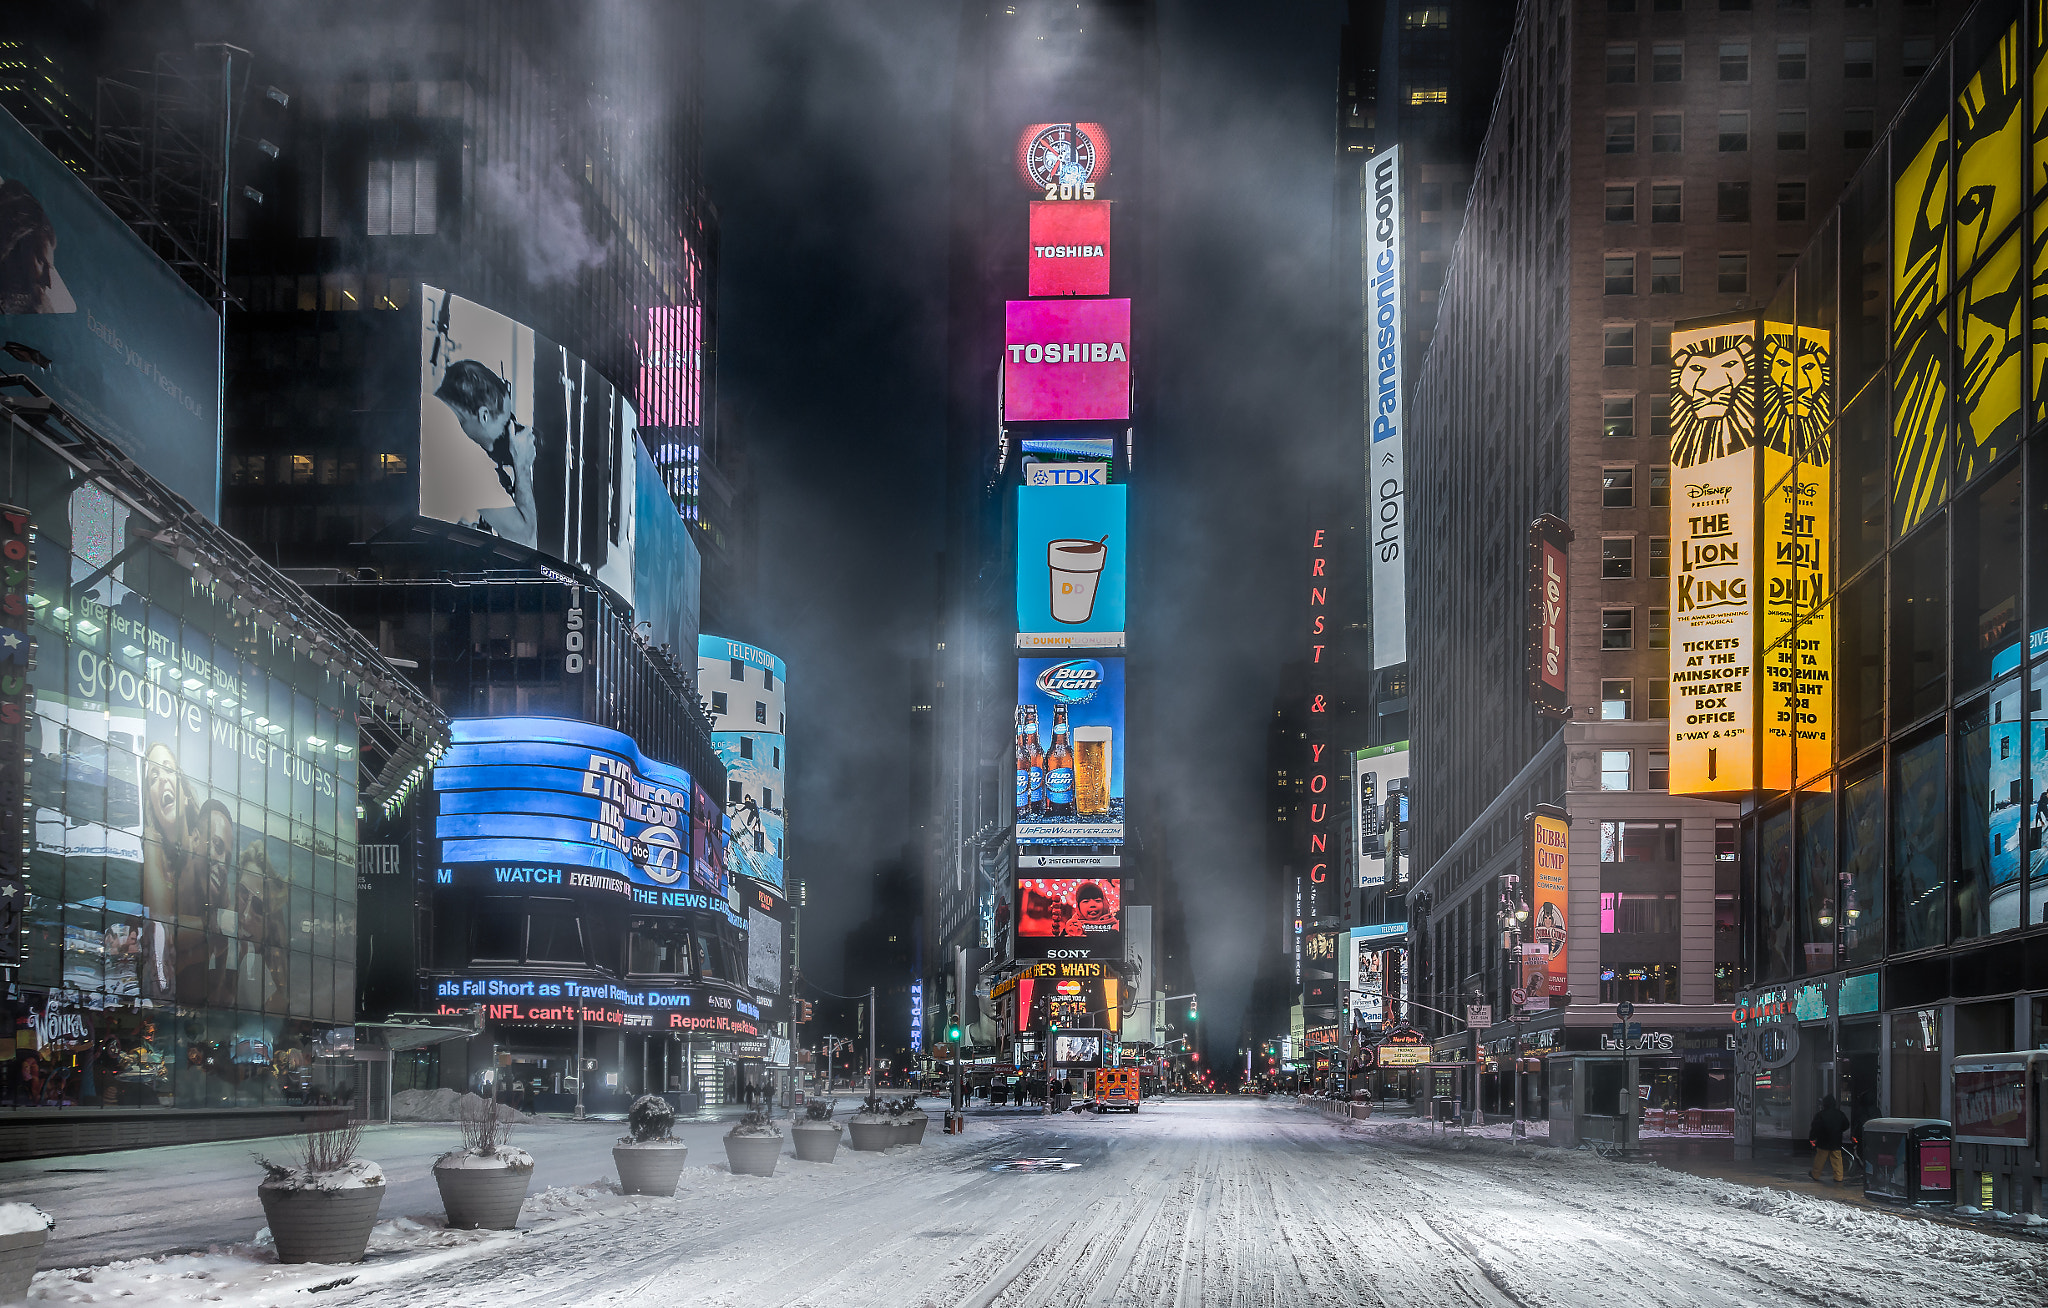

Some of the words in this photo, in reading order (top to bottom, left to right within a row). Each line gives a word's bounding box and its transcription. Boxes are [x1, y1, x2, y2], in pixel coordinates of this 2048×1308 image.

[1045, 183, 1096, 200] 2015
[1034, 246, 1104, 258] TOSHIBA
[1371, 157, 1396, 443] Panasonic.com
[1007, 343, 1126, 364] TOSHIBA
[87, 308, 124, 354] battle
[125, 344, 153, 377] your
[153, 362, 184, 405] heart
[184, 394, 204, 420] out
[1049, 468, 1101, 485] TDK
[1691, 499, 1730, 508] PRESENTS
[1375, 478, 1403, 563] shop
[1688, 513, 1730, 535] THE
[3, 511, 28, 616] TOYS
[1681, 540, 1739, 573] LION
[1061, 582, 1085, 595] DD
[1311, 529, 1327, 663] ERNST
[1677, 574, 1748, 613] KING
[1691, 610, 1749, 621] AWARD-WINNING
[1705, 618, 1734, 626] MUSICAL
[565, 586, 584, 674] 1500
[80, 596, 131, 635] greater
[133, 620, 171, 656] FORT
[171, 640, 248, 700] LAUDERDALE
[1033, 637, 1075, 645] DUNKIN'
[1683, 638, 1740, 652] TICKETS
[726, 642, 775, 669] TELEVISION
[1686, 655, 1705, 667] AT
[1709, 653, 1736, 665] THE
[1054, 668, 1097, 679] BUD
[1672, 666, 1750, 682] MINSKOFF
[1046, 679, 1102, 690] LIGHT
[1680, 681, 1742, 697] THEATRE
[1, 674, 24, 725] US
[1311, 694, 1327, 713] &
[1695, 698, 1727, 710] BOX
[77, 650, 203, 737] goodbye
[210, 716, 278, 768] winter
[1686, 711, 1736, 725] OFFICE
[1676, 731, 1711, 741] B'WAY
[1712, 730, 1720, 738] &
[1310, 744, 1327, 883] YOUNG
[1536, 823, 1567, 849] BUBBA
[632, 843, 649, 859] abc
[1538, 848, 1565, 870] GUMP
[1537, 881, 1565, 891] COMPANY
[1539, 873, 1562, 883] SHRIMP
[495, 867, 562, 884] WATCH
[570, 873, 623, 894] EYEWITNESS
[632, 888, 658, 904] THE
[661, 892, 708, 909] NEWS
[1380, 924, 1405, 934] TELEVISION
[1536, 927, 1551, 939] BUBBA
[1551, 928, 1566, 940] GUMP
[1047, 949, 1091, 959] SONY
[1061, 963, 1101, 977] WHAT'S
[438, 980, 460, 996] als
[463, 980, 486, 996] Fall
[488, 980, 535, 996] Short
[538, 984, 561, 996] as
[564, 982, 608, 998] Travel
[648, 992, 691, 1006] Down
[714, 998, 732, 1010] NEWS
[1749, 1001, 1793, 1020] OAKLEY
[28, 1001, 88, 1051] WONKA
[489, 1004, 525, 1020] NFL
[528, 1006, 575, 1021] can't
[577, 1006, 605, 1022] ind
[624, 1014, 653, 1027] ESPN
[670, 1013, 716, 1031] Report:
[717, 1016, 731, 1031] NFL
